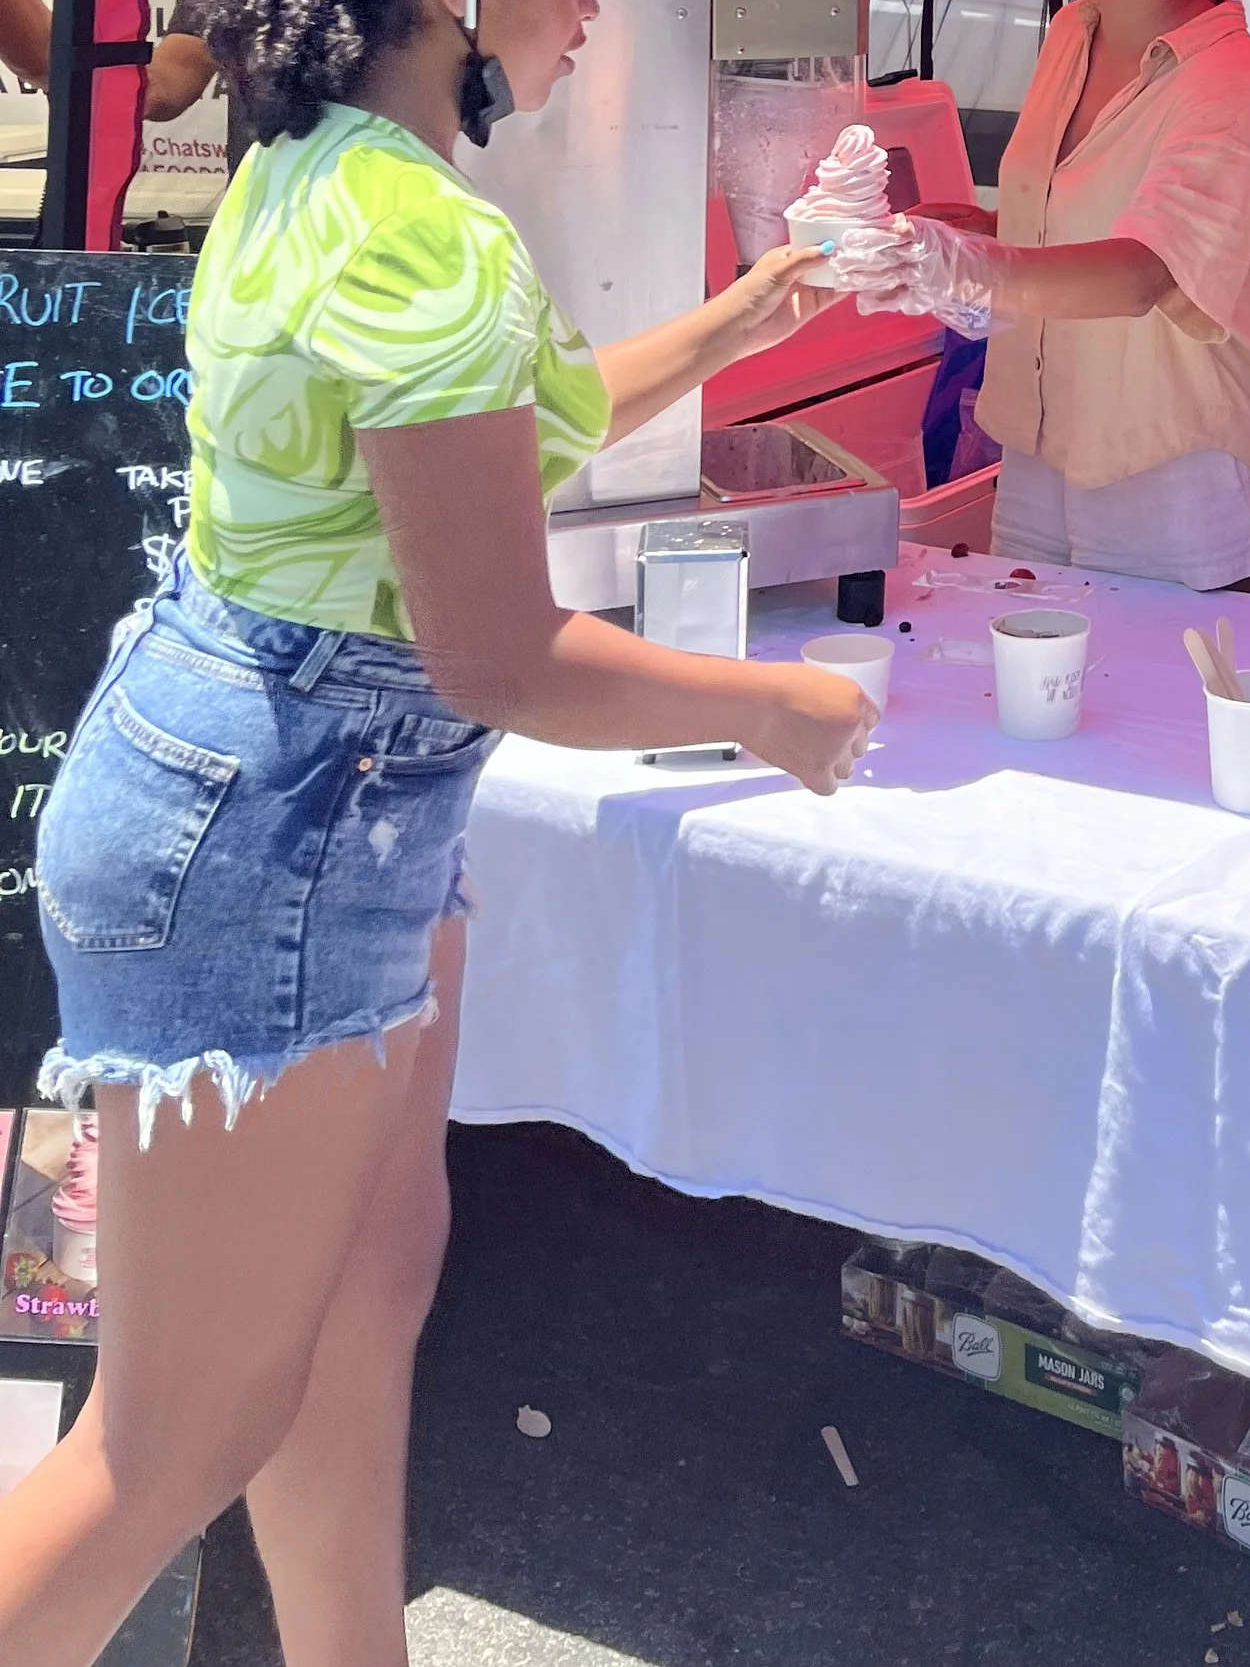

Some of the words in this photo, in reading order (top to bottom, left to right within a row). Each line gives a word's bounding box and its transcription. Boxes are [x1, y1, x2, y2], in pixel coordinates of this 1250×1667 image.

[60, 370, 113, 401] TO
[130, 368, 193, 406] OR
[958, 1331, 994, 1356] Ball
[1038, 1353, 1076, 1380] MASON
[1078, 1368, 1105, 1391] JARS
